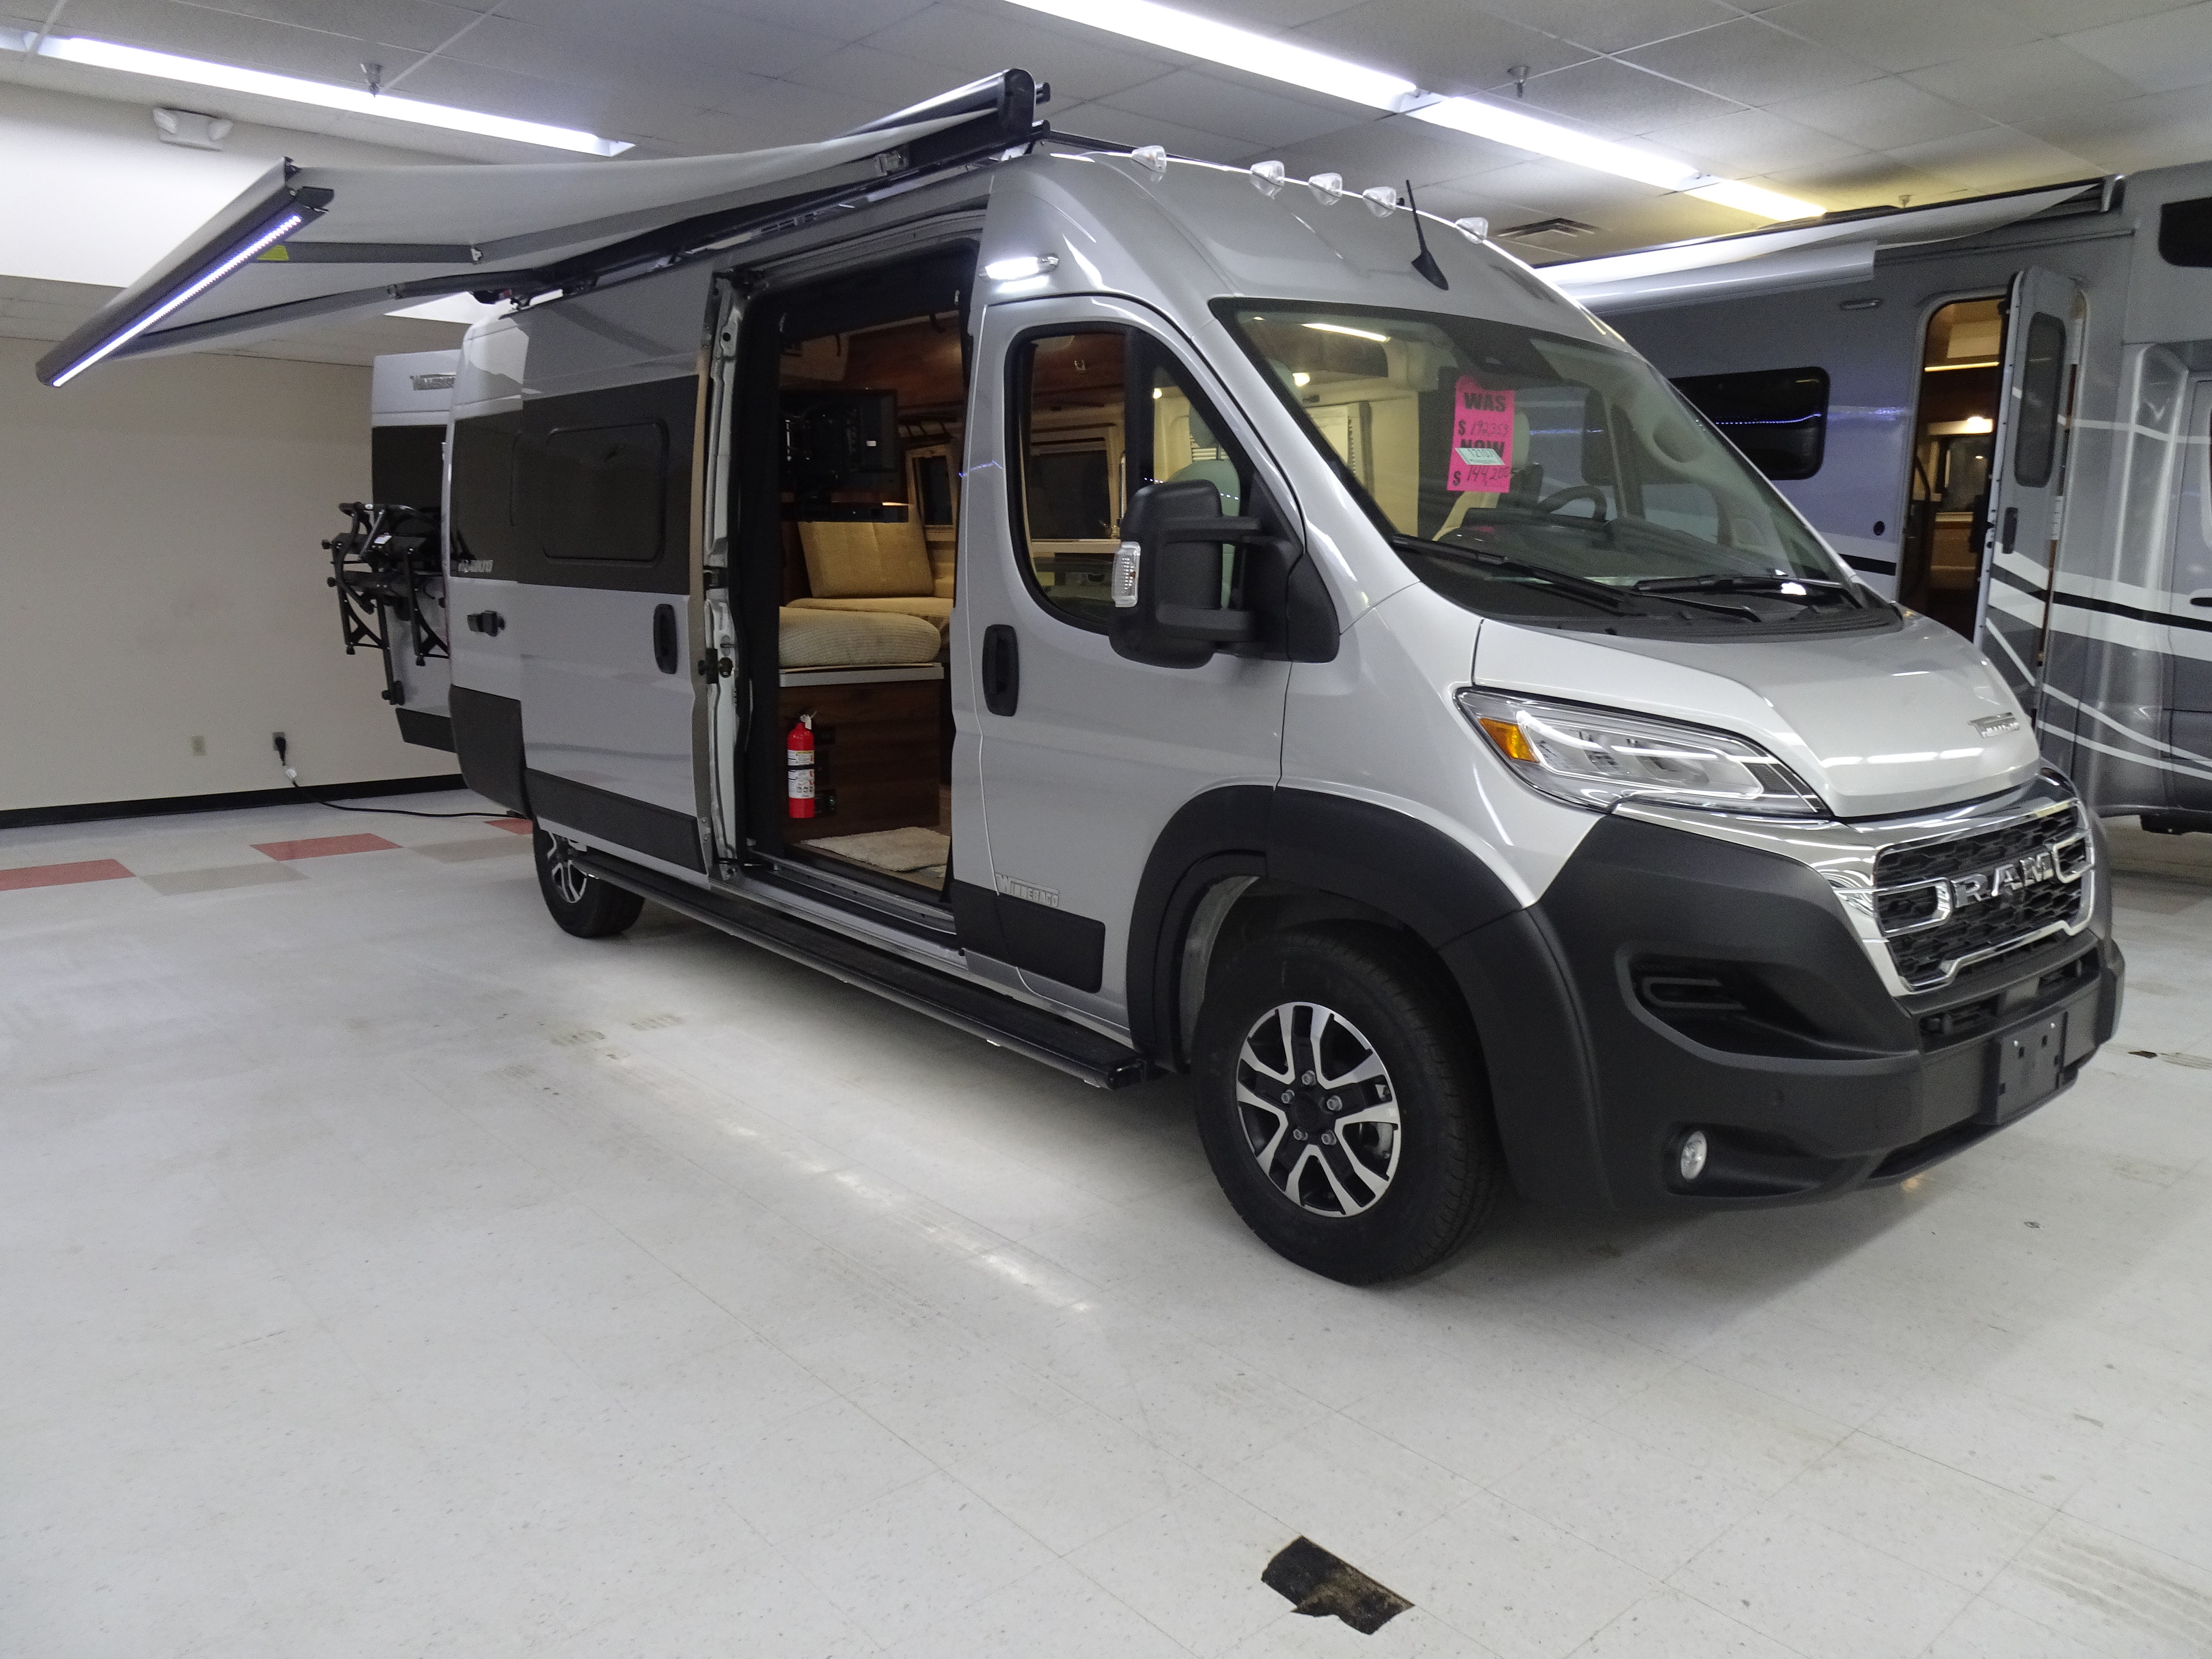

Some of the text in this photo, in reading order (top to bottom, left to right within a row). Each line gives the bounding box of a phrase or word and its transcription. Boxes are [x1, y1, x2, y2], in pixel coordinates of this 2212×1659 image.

[1465, 393, 1505, 412] WAS
[1458, 420, 1466, 436] $
[1453, 471, 1461, 486] $
[1951, 852, 2054, 908] RAM
